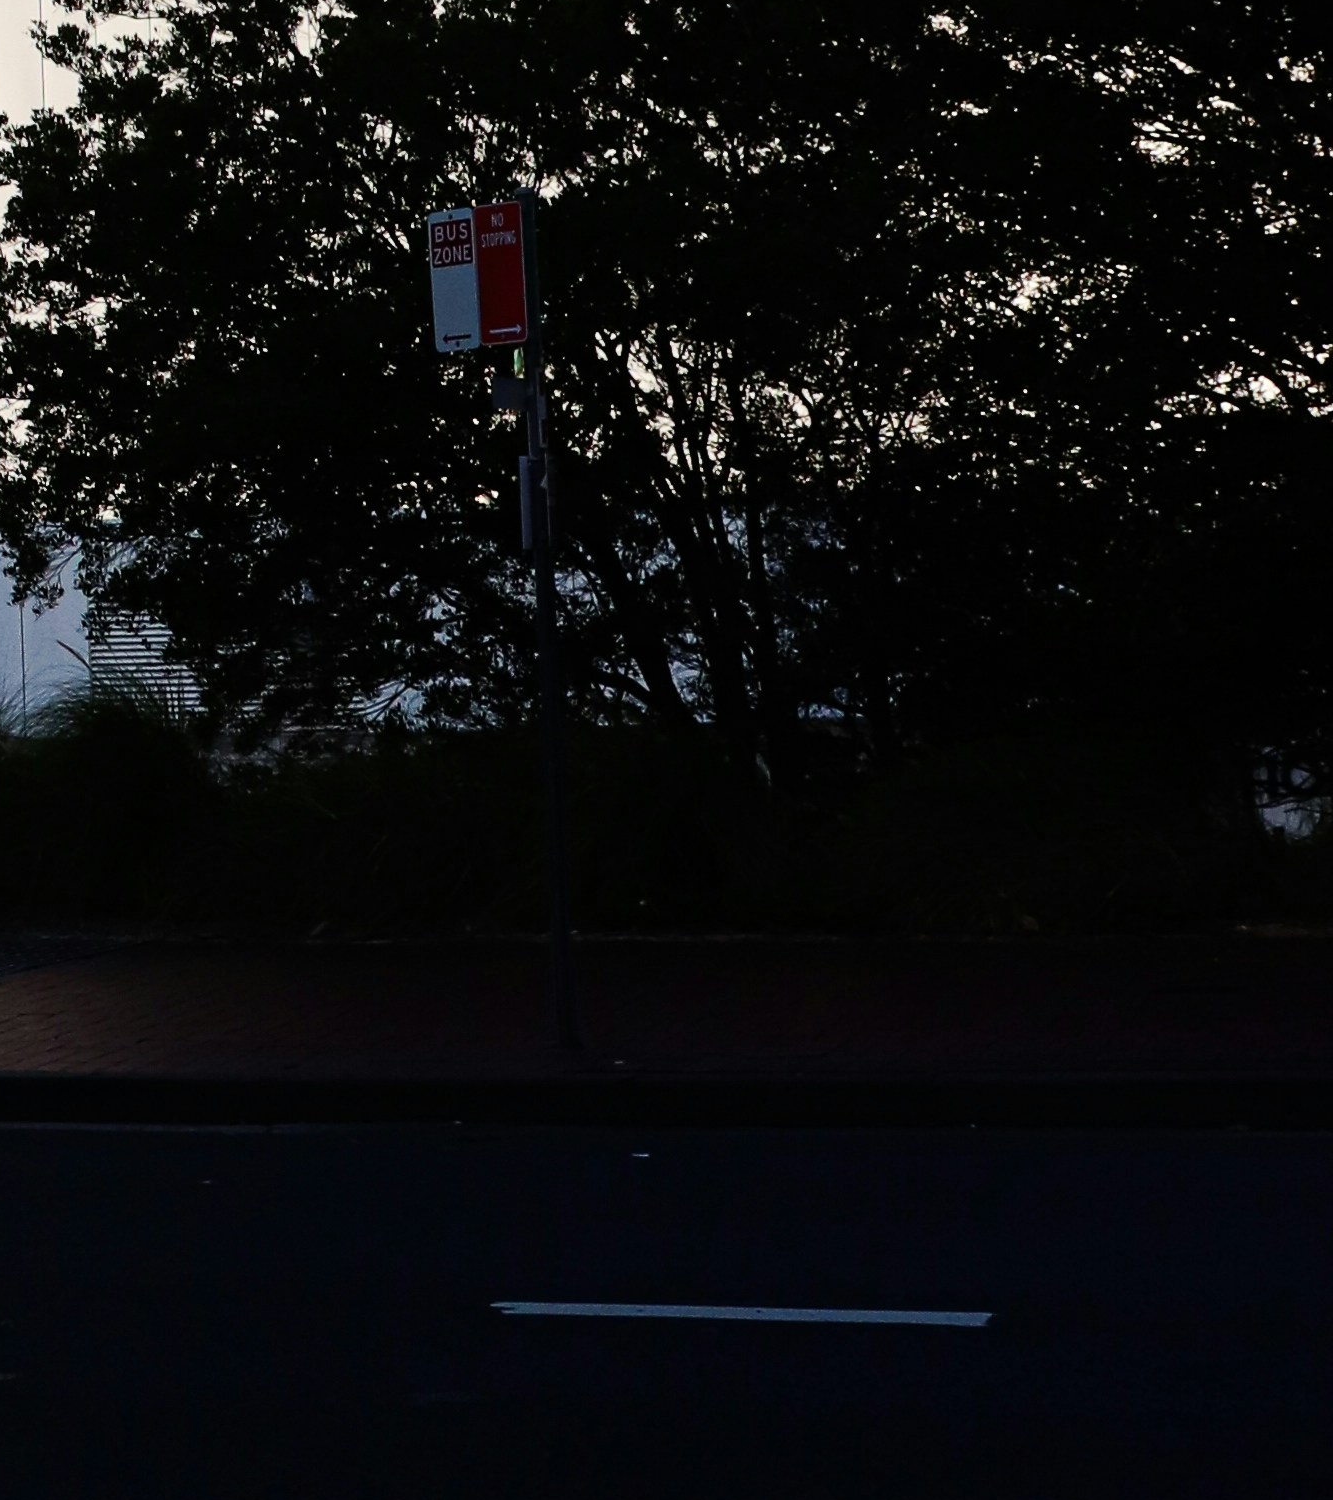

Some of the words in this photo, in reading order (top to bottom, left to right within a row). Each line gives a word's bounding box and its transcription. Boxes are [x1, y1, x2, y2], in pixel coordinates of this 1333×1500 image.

[491, 212, 504, 228] NO
[434, 222, 469, 243] BUS
[481, 230, 517, 248] STOPPING
[433, 244, 472, 265] ZONE
